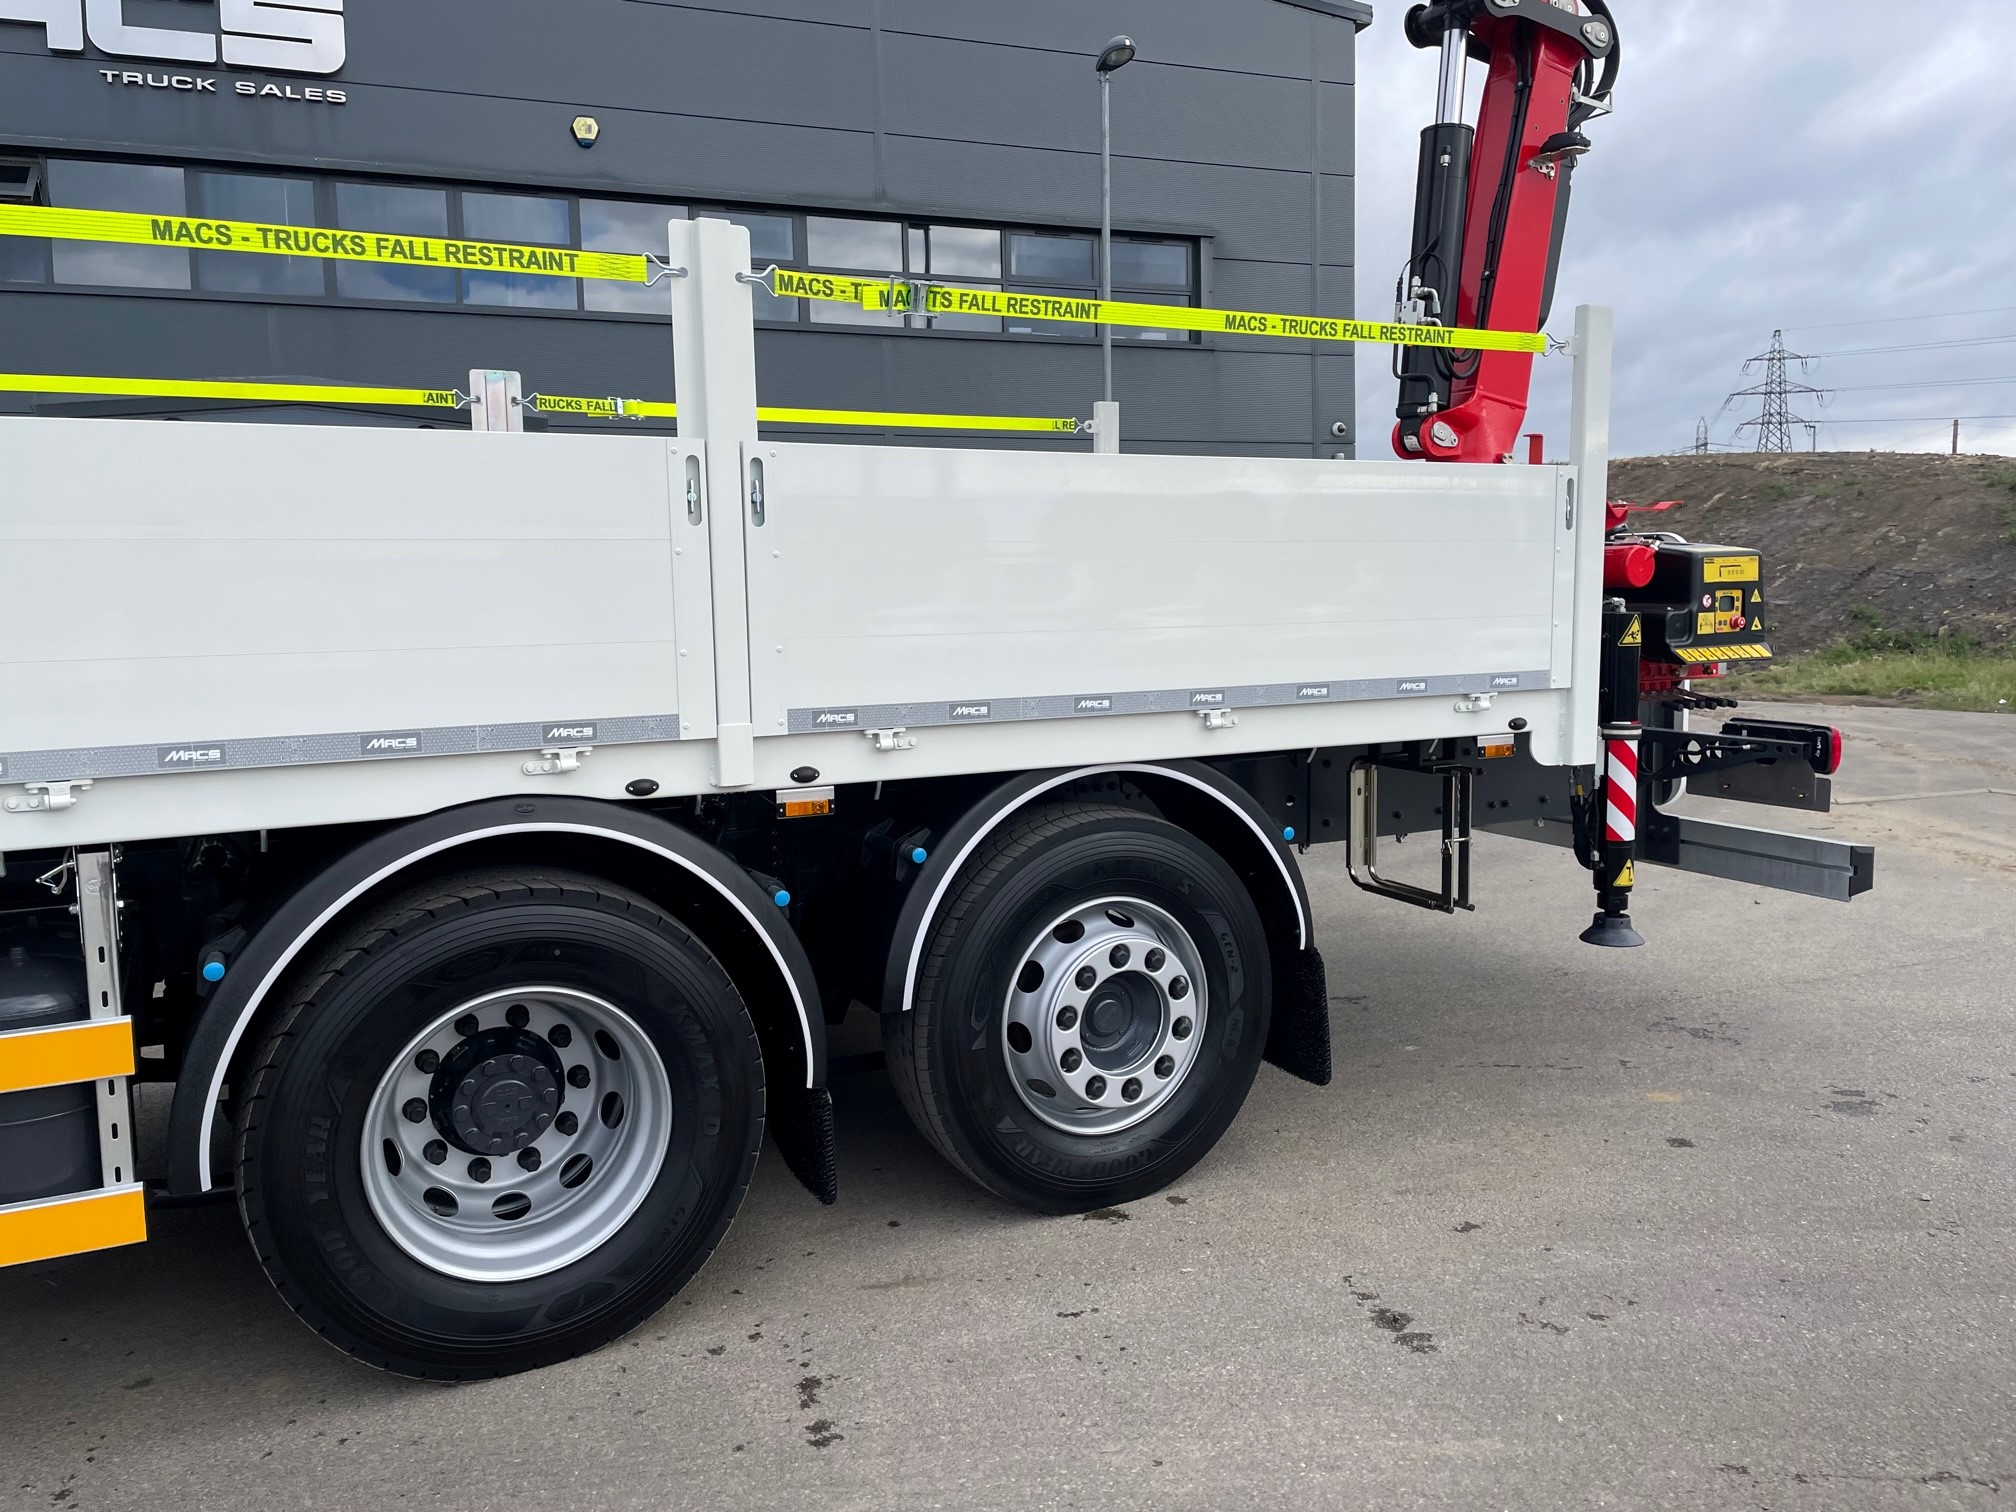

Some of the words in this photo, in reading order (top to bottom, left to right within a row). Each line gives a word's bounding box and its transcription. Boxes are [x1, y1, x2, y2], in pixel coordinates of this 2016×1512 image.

[99, 69, 217, 92] TRUCK
[235, 81, 348, 104] SALES
[151, 218, 233, 246] MACS
[256, 227, 366, 256] TRUCKS
[375, 237, 438, 262] FALL
[444, 242, 579, 273] RESTRAINT
[778, 273, 834, 297] MACS
[959, 292, 1002, 313] FALL
[1006, 296, 1102, 320] RESTRAINT
[1225, 313, 1267, 332] MACS
[1280, 318, 1338, 337] TRUCKS
[1342, 323, 1376, 339] FALL
[1380, 325, 1454, 345] RESTRAINT
[424, 392, 456, 405] AINT
[587, 400, 616, 412] FALL
[1299, 687, 1328, 696] MACS
[1399, 682, 1426, 690] MACS
[1077, 699, 1109, 708] MACS
[1192, 693, 1222, 702] MACS
[952, 706, 988, 715] MACS
[816, 713, 855, 723] MACS
[547, 727, 593, 738] MACS
[365, 737, 417, 749] MACS
[164, 749, 221, 762] MACS
